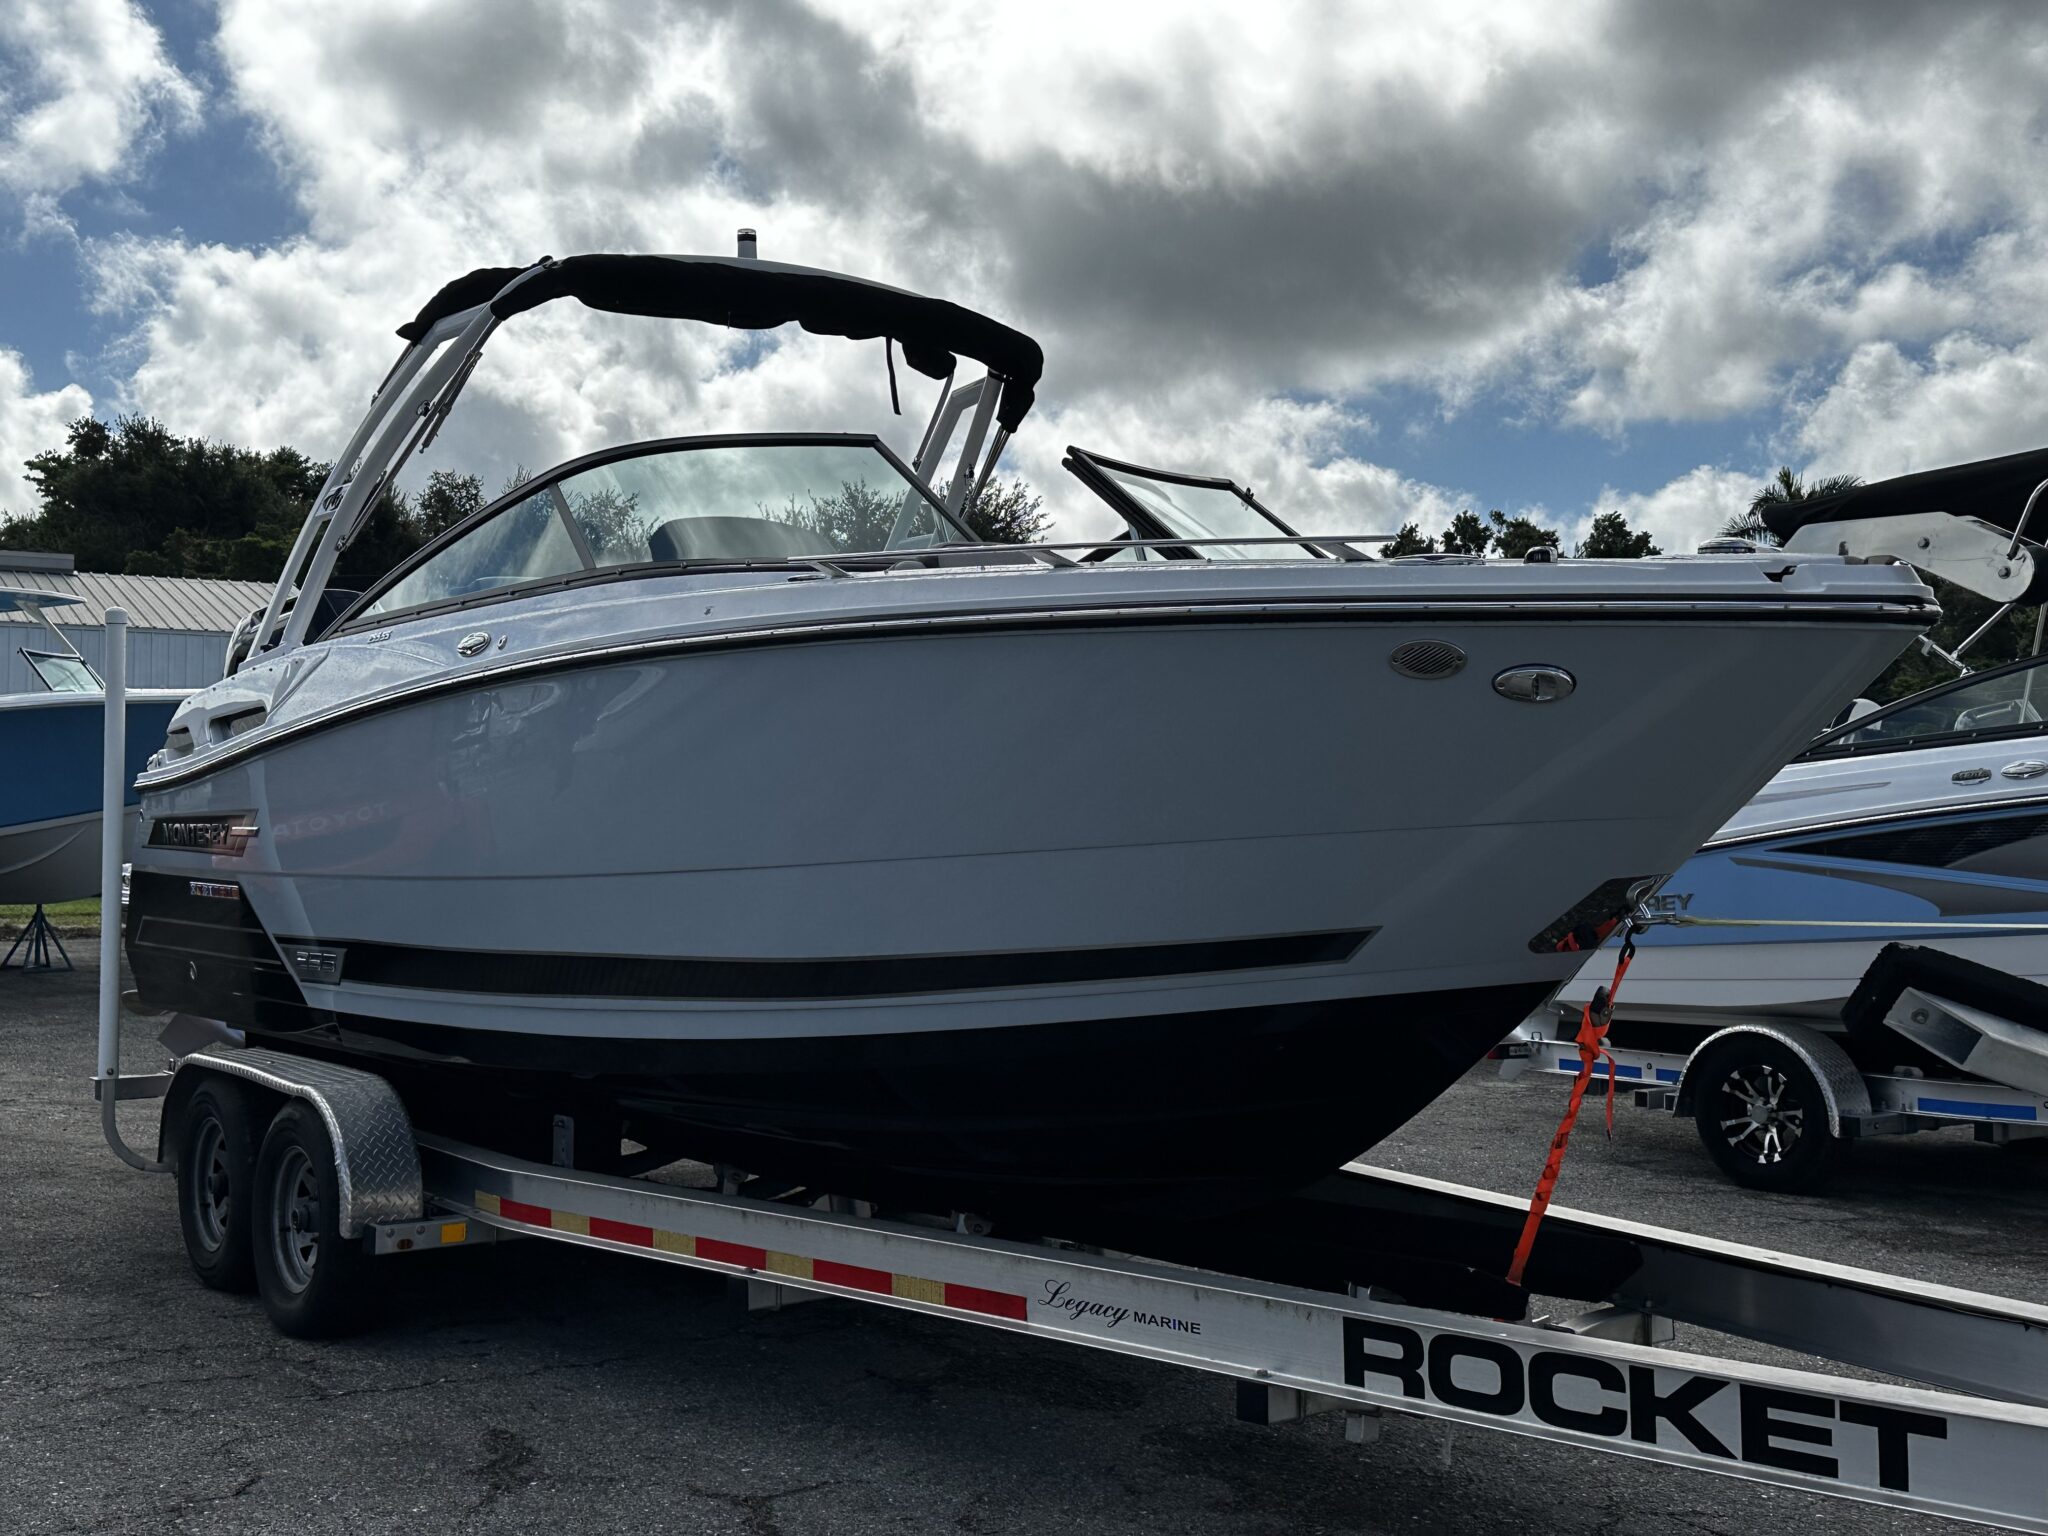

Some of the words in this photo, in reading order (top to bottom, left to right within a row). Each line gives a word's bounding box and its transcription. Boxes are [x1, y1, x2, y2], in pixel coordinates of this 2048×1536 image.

[162, 822, 229, 845] MONTEREY
[1037, 1279, 1130, 1328] Legacy
[1133, 1311, 1202, 1335] MARINE
[1343, 1317, 1948, 1492] ROCKET
